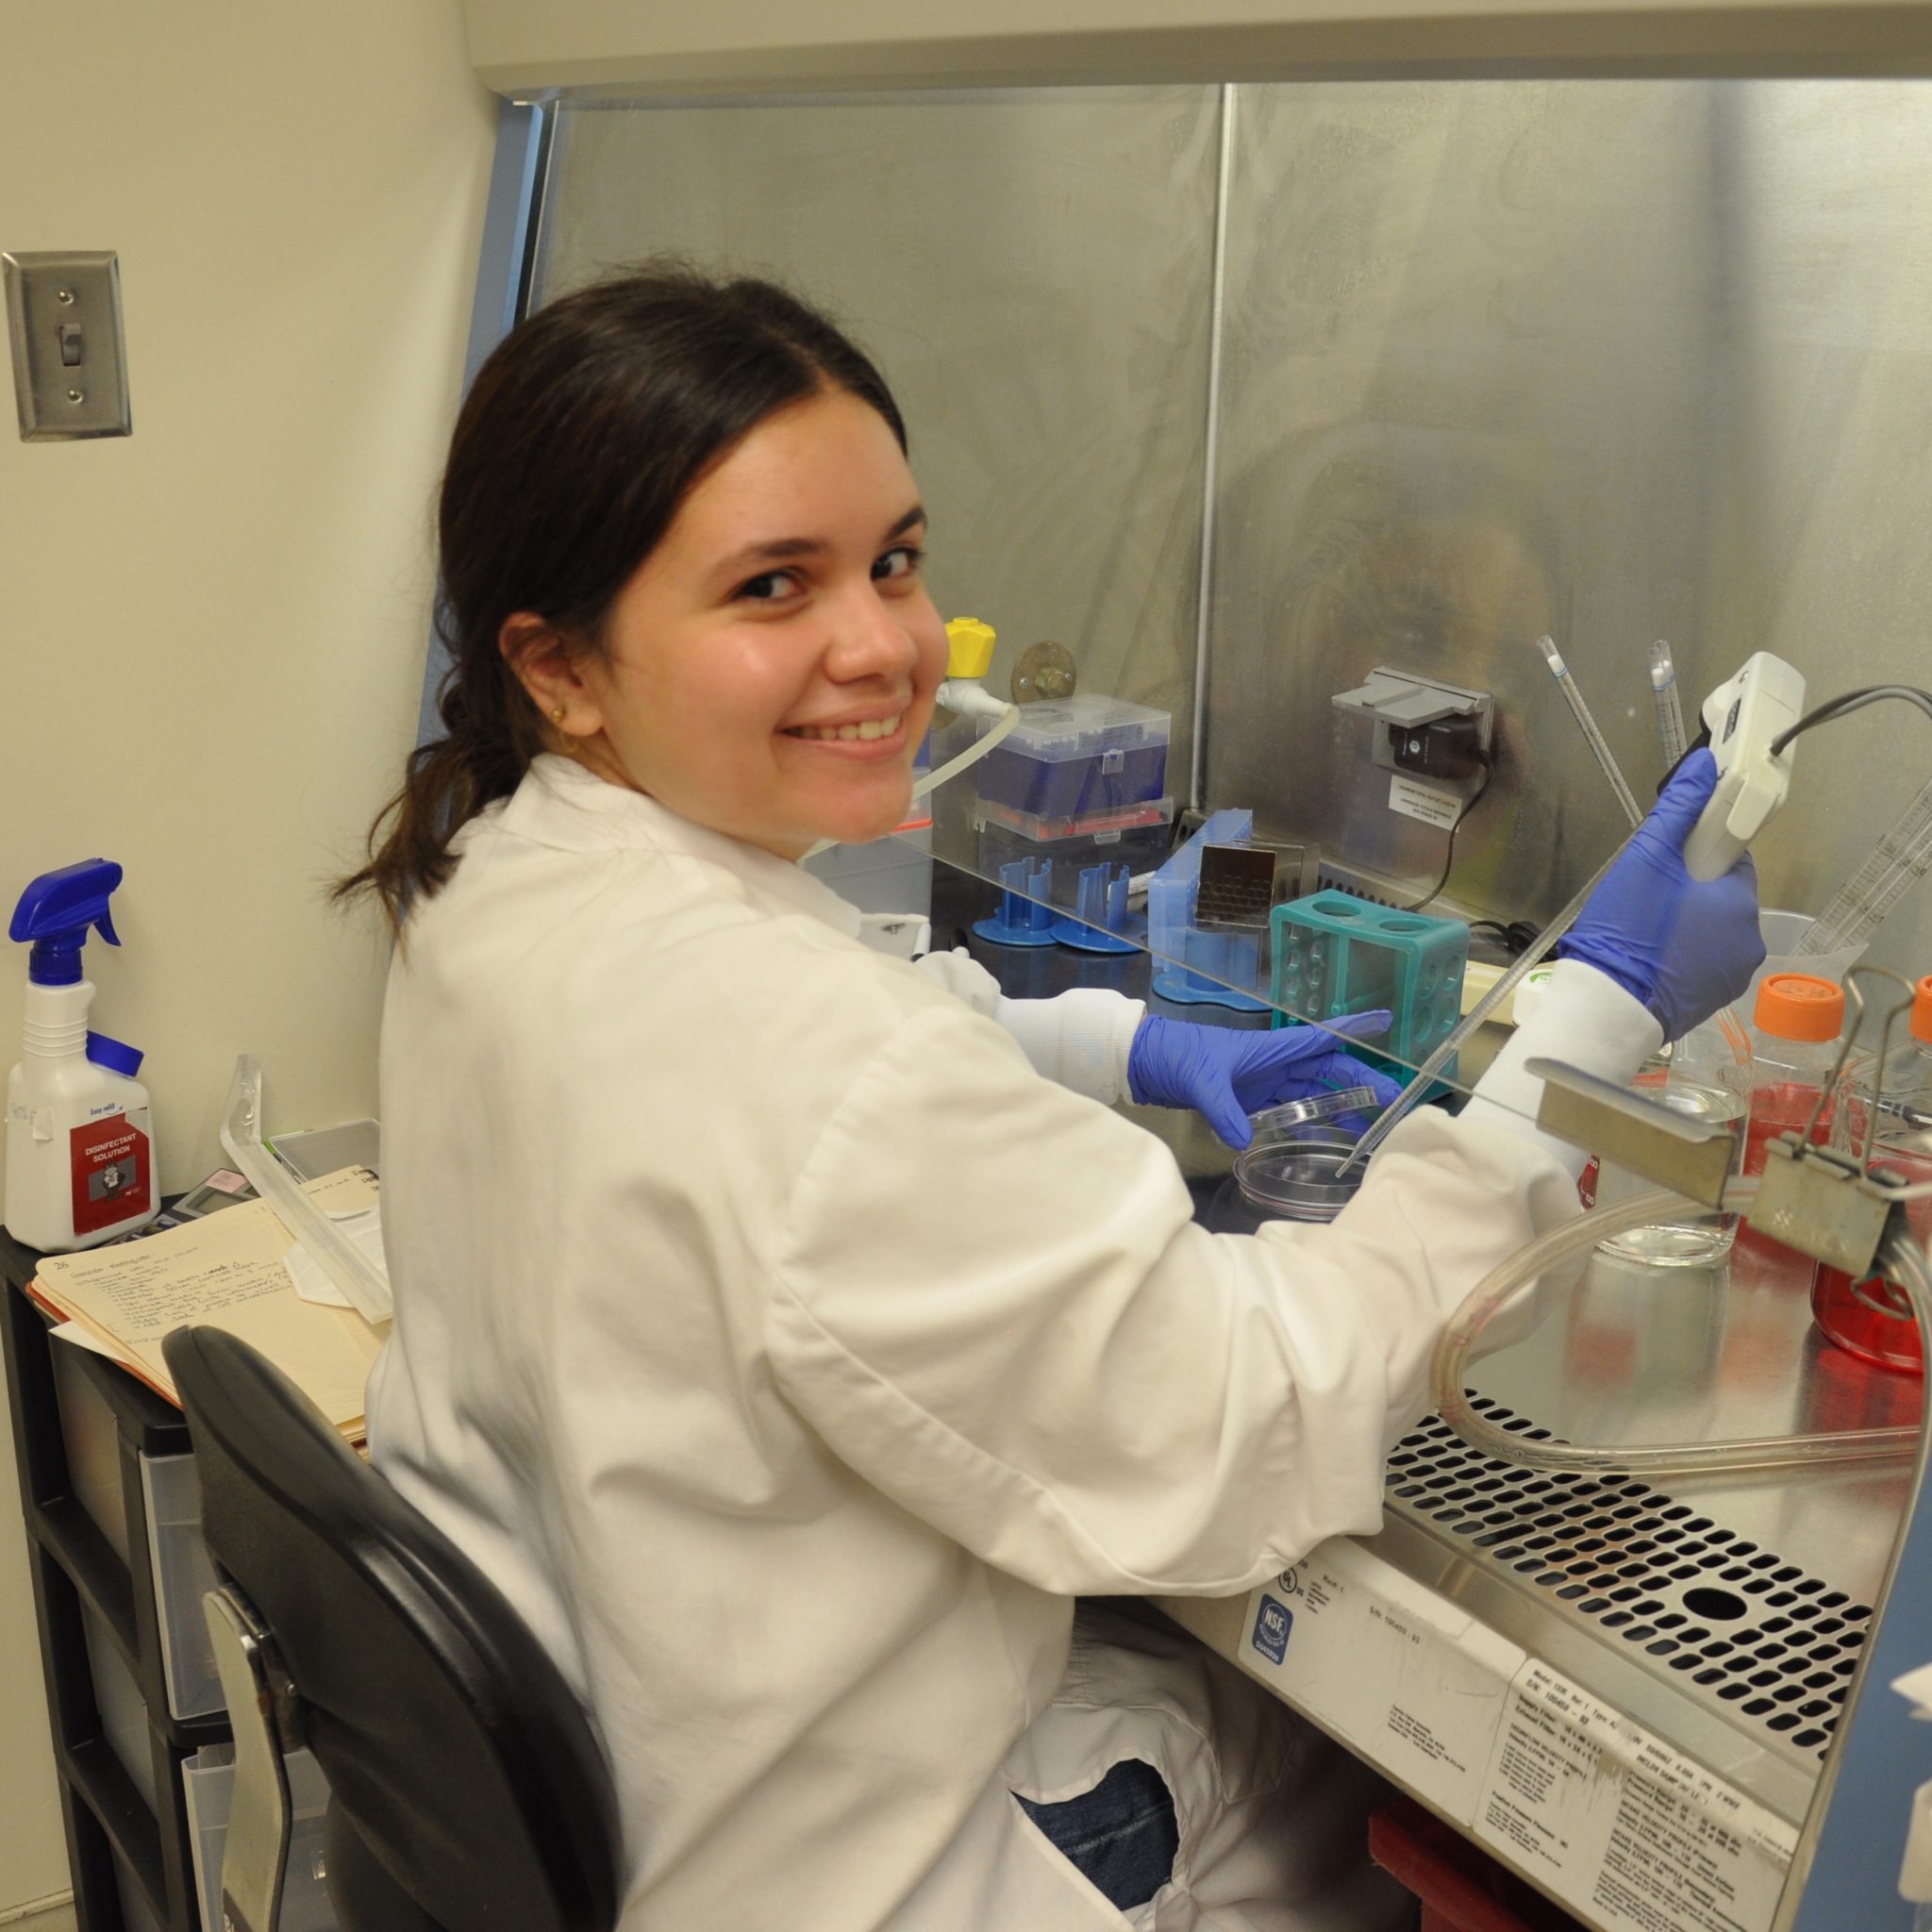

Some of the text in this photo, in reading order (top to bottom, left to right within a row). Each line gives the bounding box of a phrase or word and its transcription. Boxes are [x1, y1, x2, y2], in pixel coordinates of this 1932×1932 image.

[103, 1102, 115, 1113] refill
[85, 1132, 137, 1157] DISINFECTANT
[92, 1144, 130, 1163] SOLUTION
[54, 1261, 70, 1271] 26
[1265, 1607, 1284, 1633] NSF
